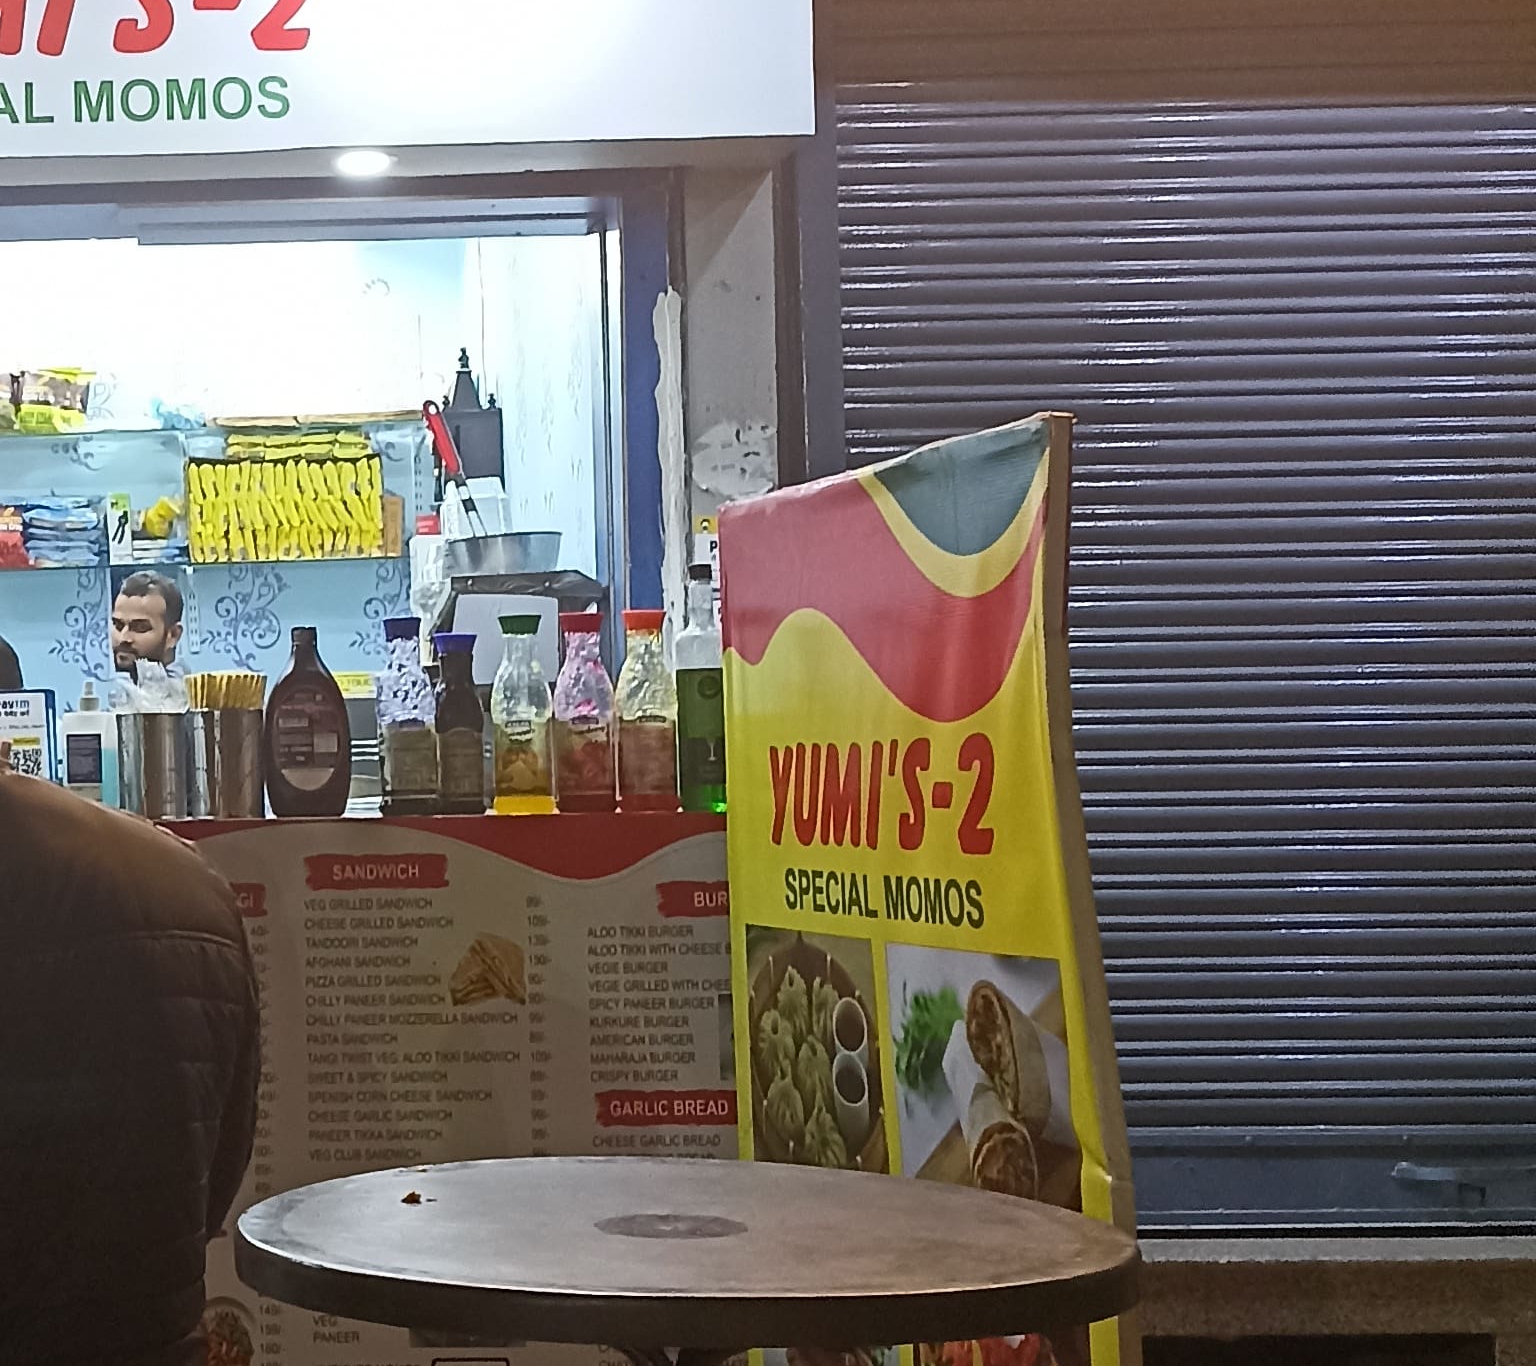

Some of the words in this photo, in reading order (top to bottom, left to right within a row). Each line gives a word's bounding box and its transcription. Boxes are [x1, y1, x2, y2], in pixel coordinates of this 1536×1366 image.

[74, 76, 290, 123] MOMOS
[769, 732, 995, 855] YUMI'S-2
[332, 864, 419, 881] SANDWICH
[376, 896, 432, 909] SANDWICH
[784, 868, 878, 919] SPECIAL
[883, 875, 985, 929] MOMOS
[304, 918, 347, 930] CHEESE
[397, 916, 453, 929] SANDWICH
[587, 926, 617, 938] ALOO
[648, 925, 694, 937] BURGER
[363, 936, 418, 948] SANDWICH
[587, 944, 617, 956] ALOO
[649, 943, 676, 955] WITH
[678, 942, 721, 955] CHEESE
[355, 955, 410, 968] SANDWICH
[623, 962, 668, 974] BURGER
[305, 976, 335, 988] PIZZA
[337, 975, 382, 988] GRILLED
[384, 975, 441, 987] SANDWICH
[623, 980, 669, 991] GRILLED
[672, 979, 699, 990] WITH
[388, 994, 445, 1005] SANDWICH
[623, 998, 666, 1010] PANEER
[669, 997, 714, 1009] BURGER
[461, 1013, 518, 1024] SANDWICH
[589, 1016, 641, 1028] KURKURE
[643, 1016, 689, 1027] BURGER
[306, 1034, 339, 1045] PASTA
[341, 1033, 398, 1044] SANDWICH
[590, 1034, 645, 1046] AMERICAN
[649, 1034, 694, 1045] BURGER
[402, 1052, 432, 1064] ALOO
[463, 1051, 520, 1063] SANDWICH
[590, 1052, 647, 1064] MAHARAJA
[650, 1051, 695, 1063] BURGER
[390, 1071, 447, 1083] SANDWICH
[590, 1070, 629, 1082] CRISPY
[633, 1070, 678, 1082] BURGER
[390, 1091, 432, 1102] CHEESE
[436, 1090, 492, 1101] SANDWICH
[610, 1100, 668, 1117] GARLIC
[673, 1100, 728, 1116] BREAD
[308, 1111, 350, 1123] CHEESE
[353, 1110, 393, 1122] GARLIC
[395, 1110, 452, 1121] SANDWICH
[308, 1130, 351, 1141] PANEER
[385, 1129, 442, 1140] SANDWICH
[592, 1135, 636, 1147] CHEESE
[639, 1134, 680, 1147] GARLIC
[683, 1134, 721, 1146] BREAD
[365, 1148, 421, 1160] SANDWICH
[313, 1331, 360, 1343] PANEER
